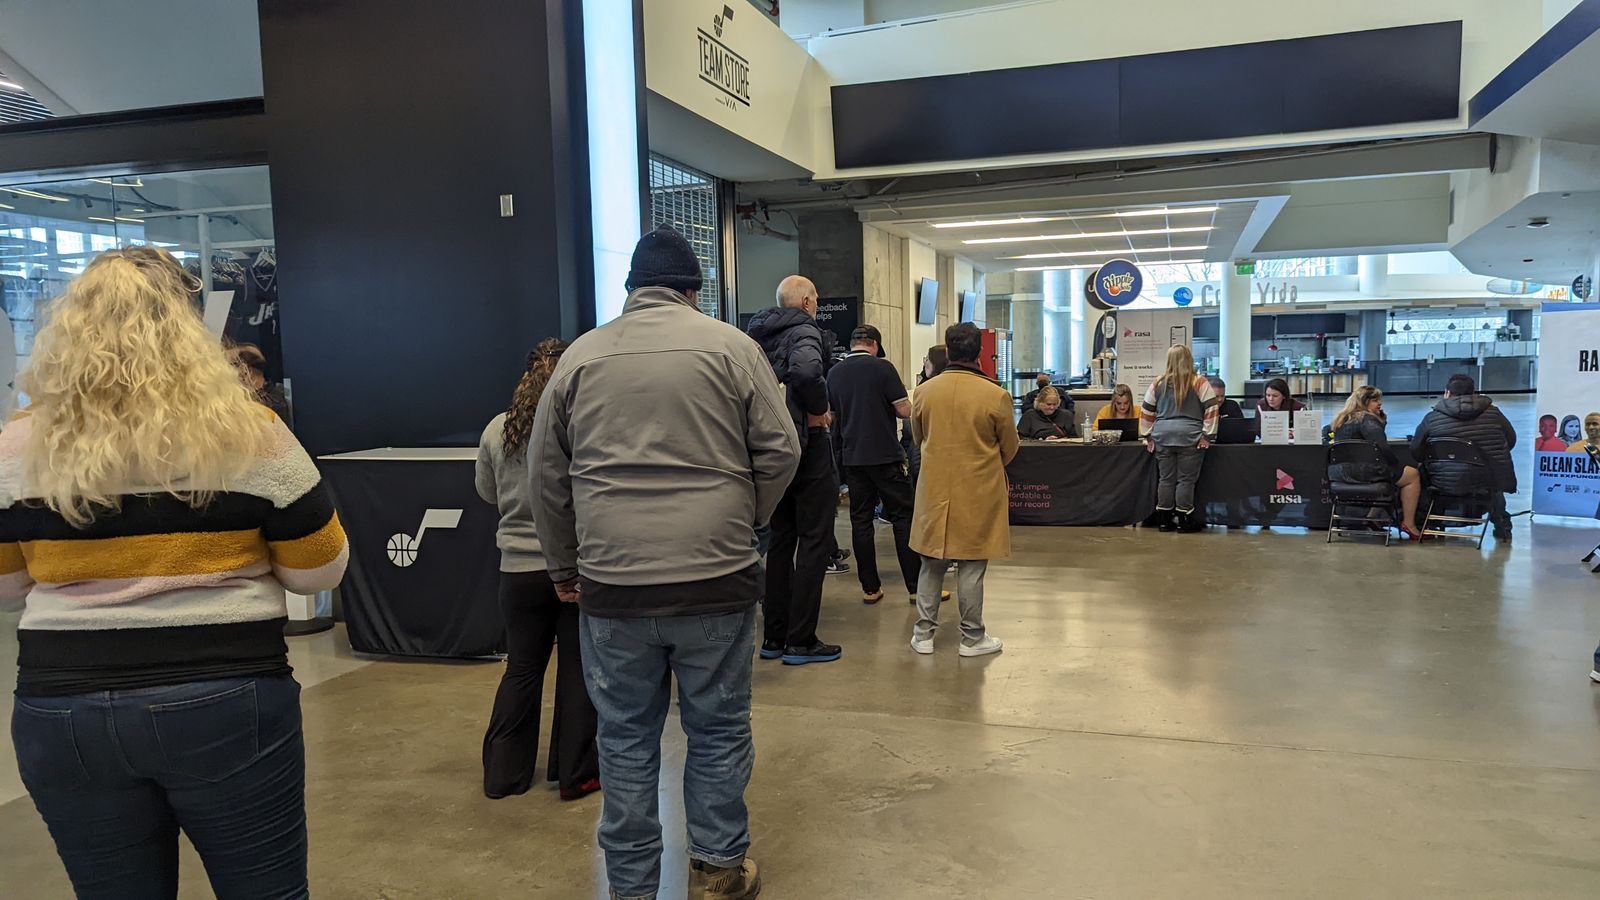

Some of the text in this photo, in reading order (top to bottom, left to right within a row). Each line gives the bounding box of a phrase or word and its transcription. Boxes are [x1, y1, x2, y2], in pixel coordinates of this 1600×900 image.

[697, 35, 750, 100] TEAM STORE
[816, 303, 848, 311] eedback
[816, 312, 832, 321] elps
[1540, 456, 1572, 472] CLEAN
[1023, 484, 1049, 492] simple
[1269, 494, 1302, 504] rasa
